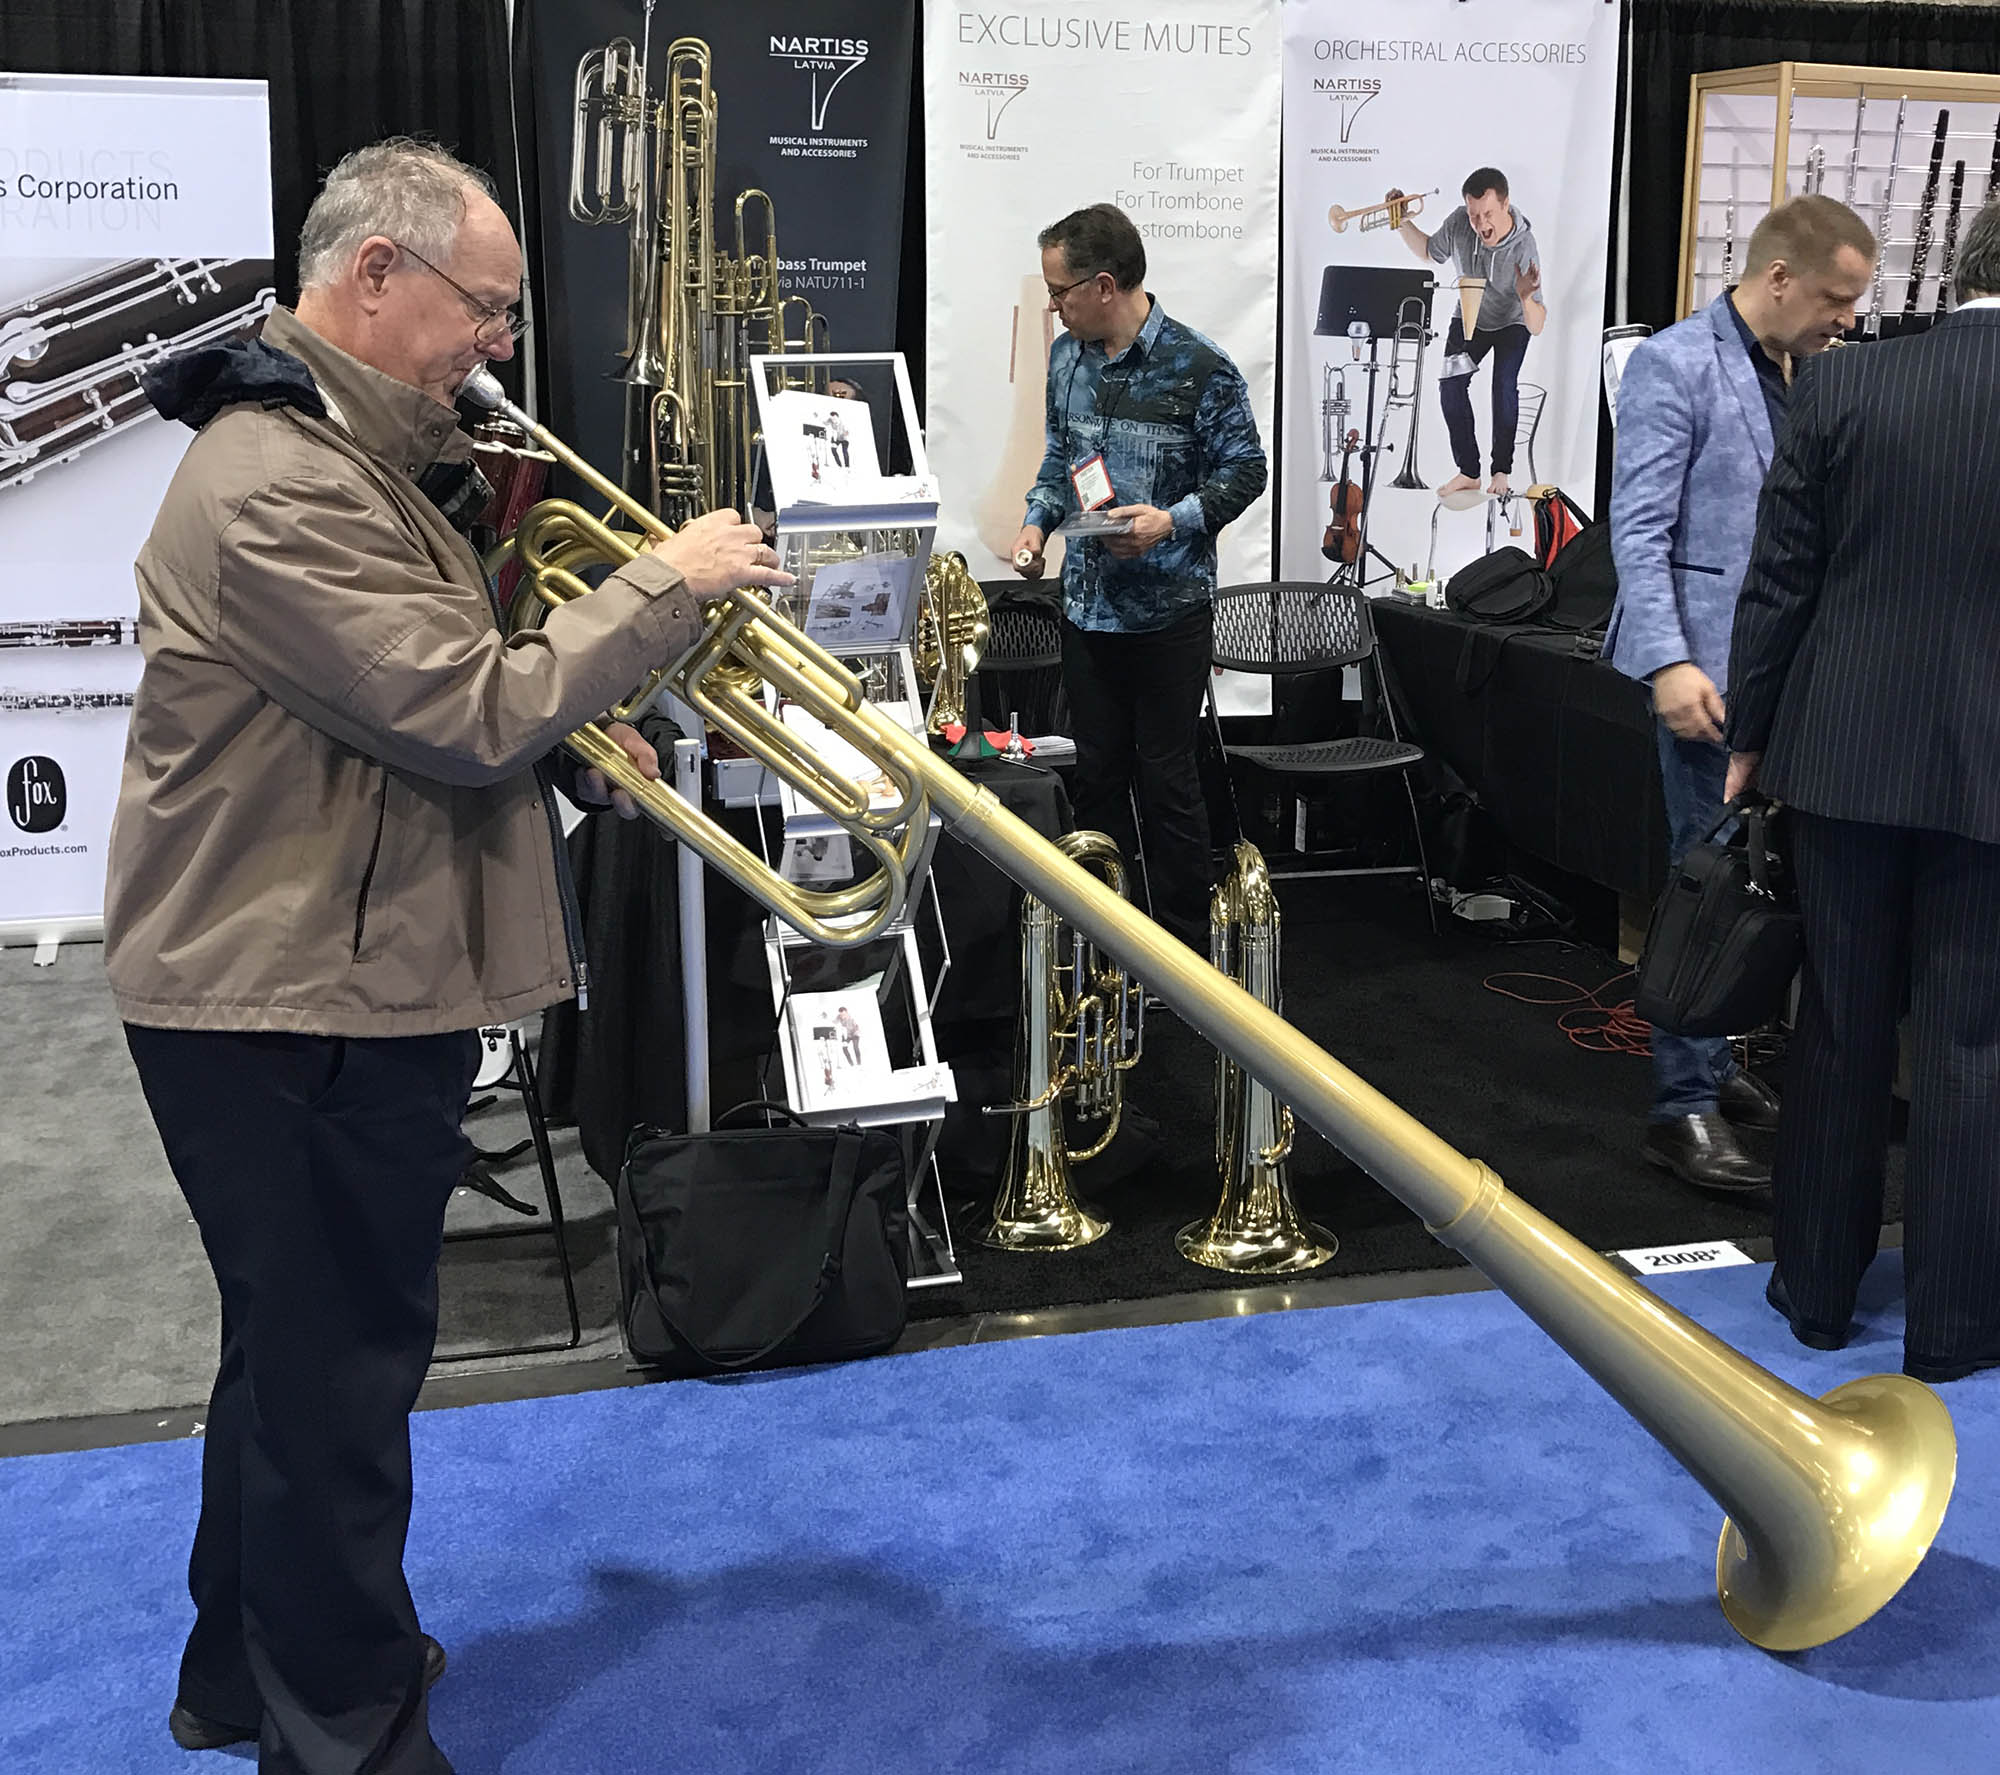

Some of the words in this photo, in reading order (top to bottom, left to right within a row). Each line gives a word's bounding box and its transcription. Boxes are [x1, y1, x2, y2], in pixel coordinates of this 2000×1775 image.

[958, 13, 1131, 50] EXCLUSIVE
[1144, 22, 1252, 56] MUTES
[770, 36, 869, 55] NARTISS
[1313, 39, 1448, 62] ORCHESTRAL
[1454, 42, 1586, 64] ACCESSORIES
[794, 60, 836, 70] LATVIA
[959, 72, 1029, 86] NARTISS
[1313, 78, 1382, 90] NARTISS
[769, 136, 808, 146] MUSICAL
[809, 138, 868, 147] INSTRUMENTS
[781, 148, 800, 156] AND
[801, 148, 857, 158] ACCESSORIES
[1133, 161, 1162, 180] For
[1166, 162, 1244, 186] Trumpet
[18, 174, 179, 204] Corporation
[1115, 190, 1144, 209] For
[1148, 191, 1244, 210] Trombone
[808, 258, 867, 274] Trumpet
[795, 276, 865, 289] NATU711-1
[1120, 421, 1138, 432] ON
[16, 758, 57, 827] fox
